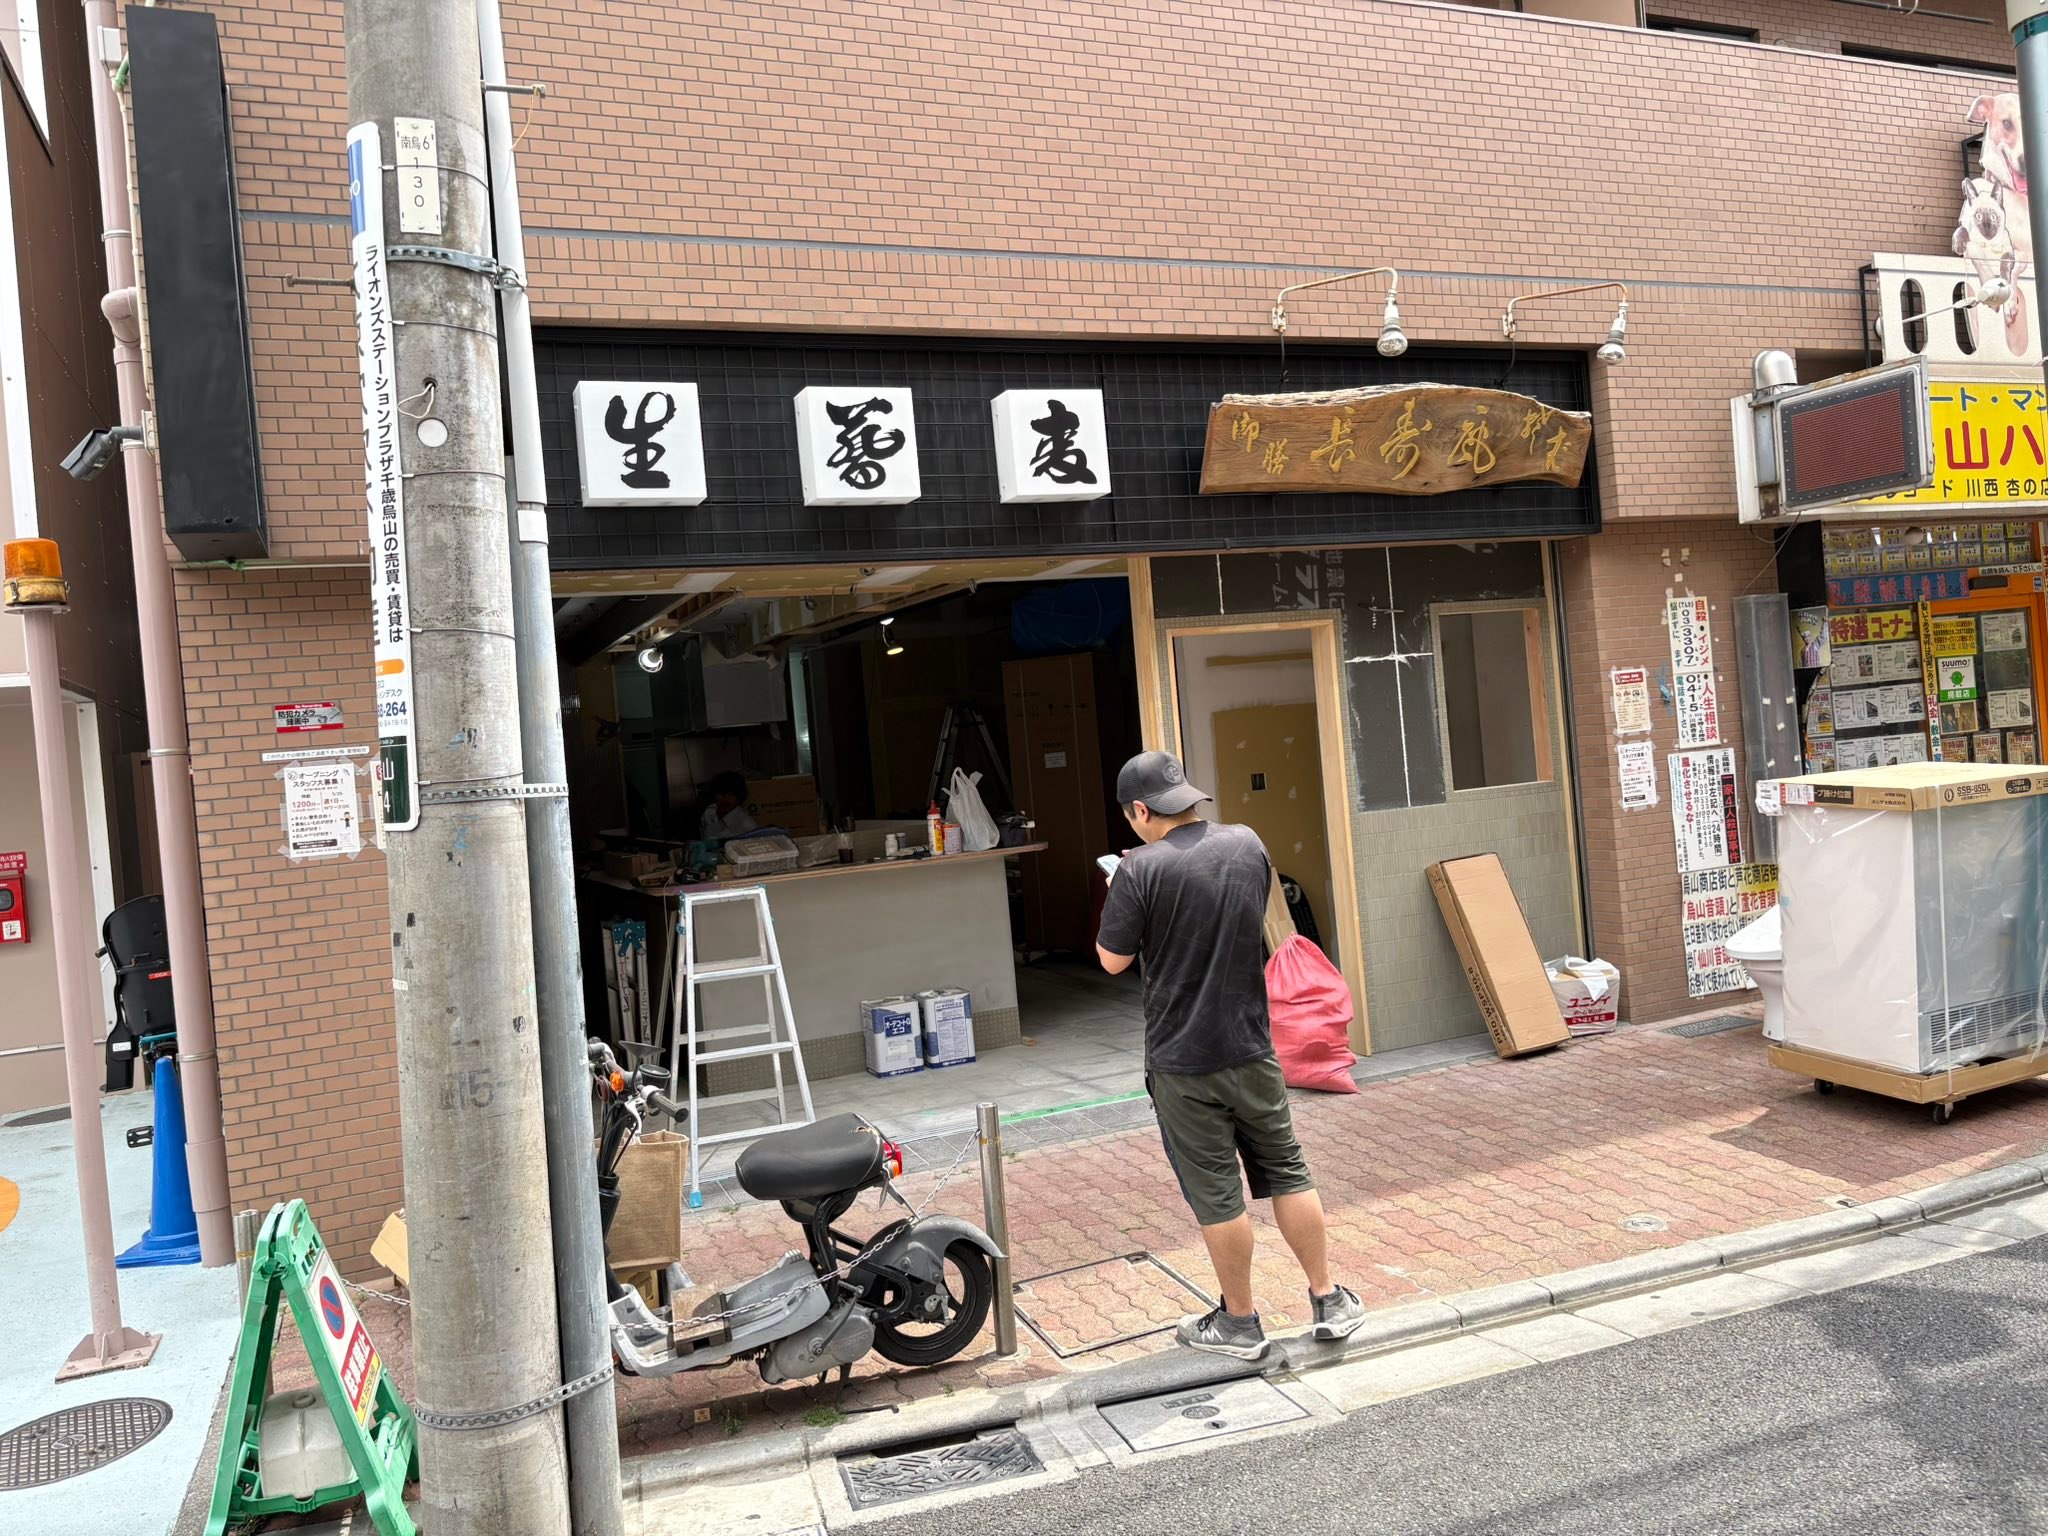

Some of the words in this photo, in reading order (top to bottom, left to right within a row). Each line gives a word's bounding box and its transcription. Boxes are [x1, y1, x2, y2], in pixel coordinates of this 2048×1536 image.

[299, 770, 339, 779] オープニング
